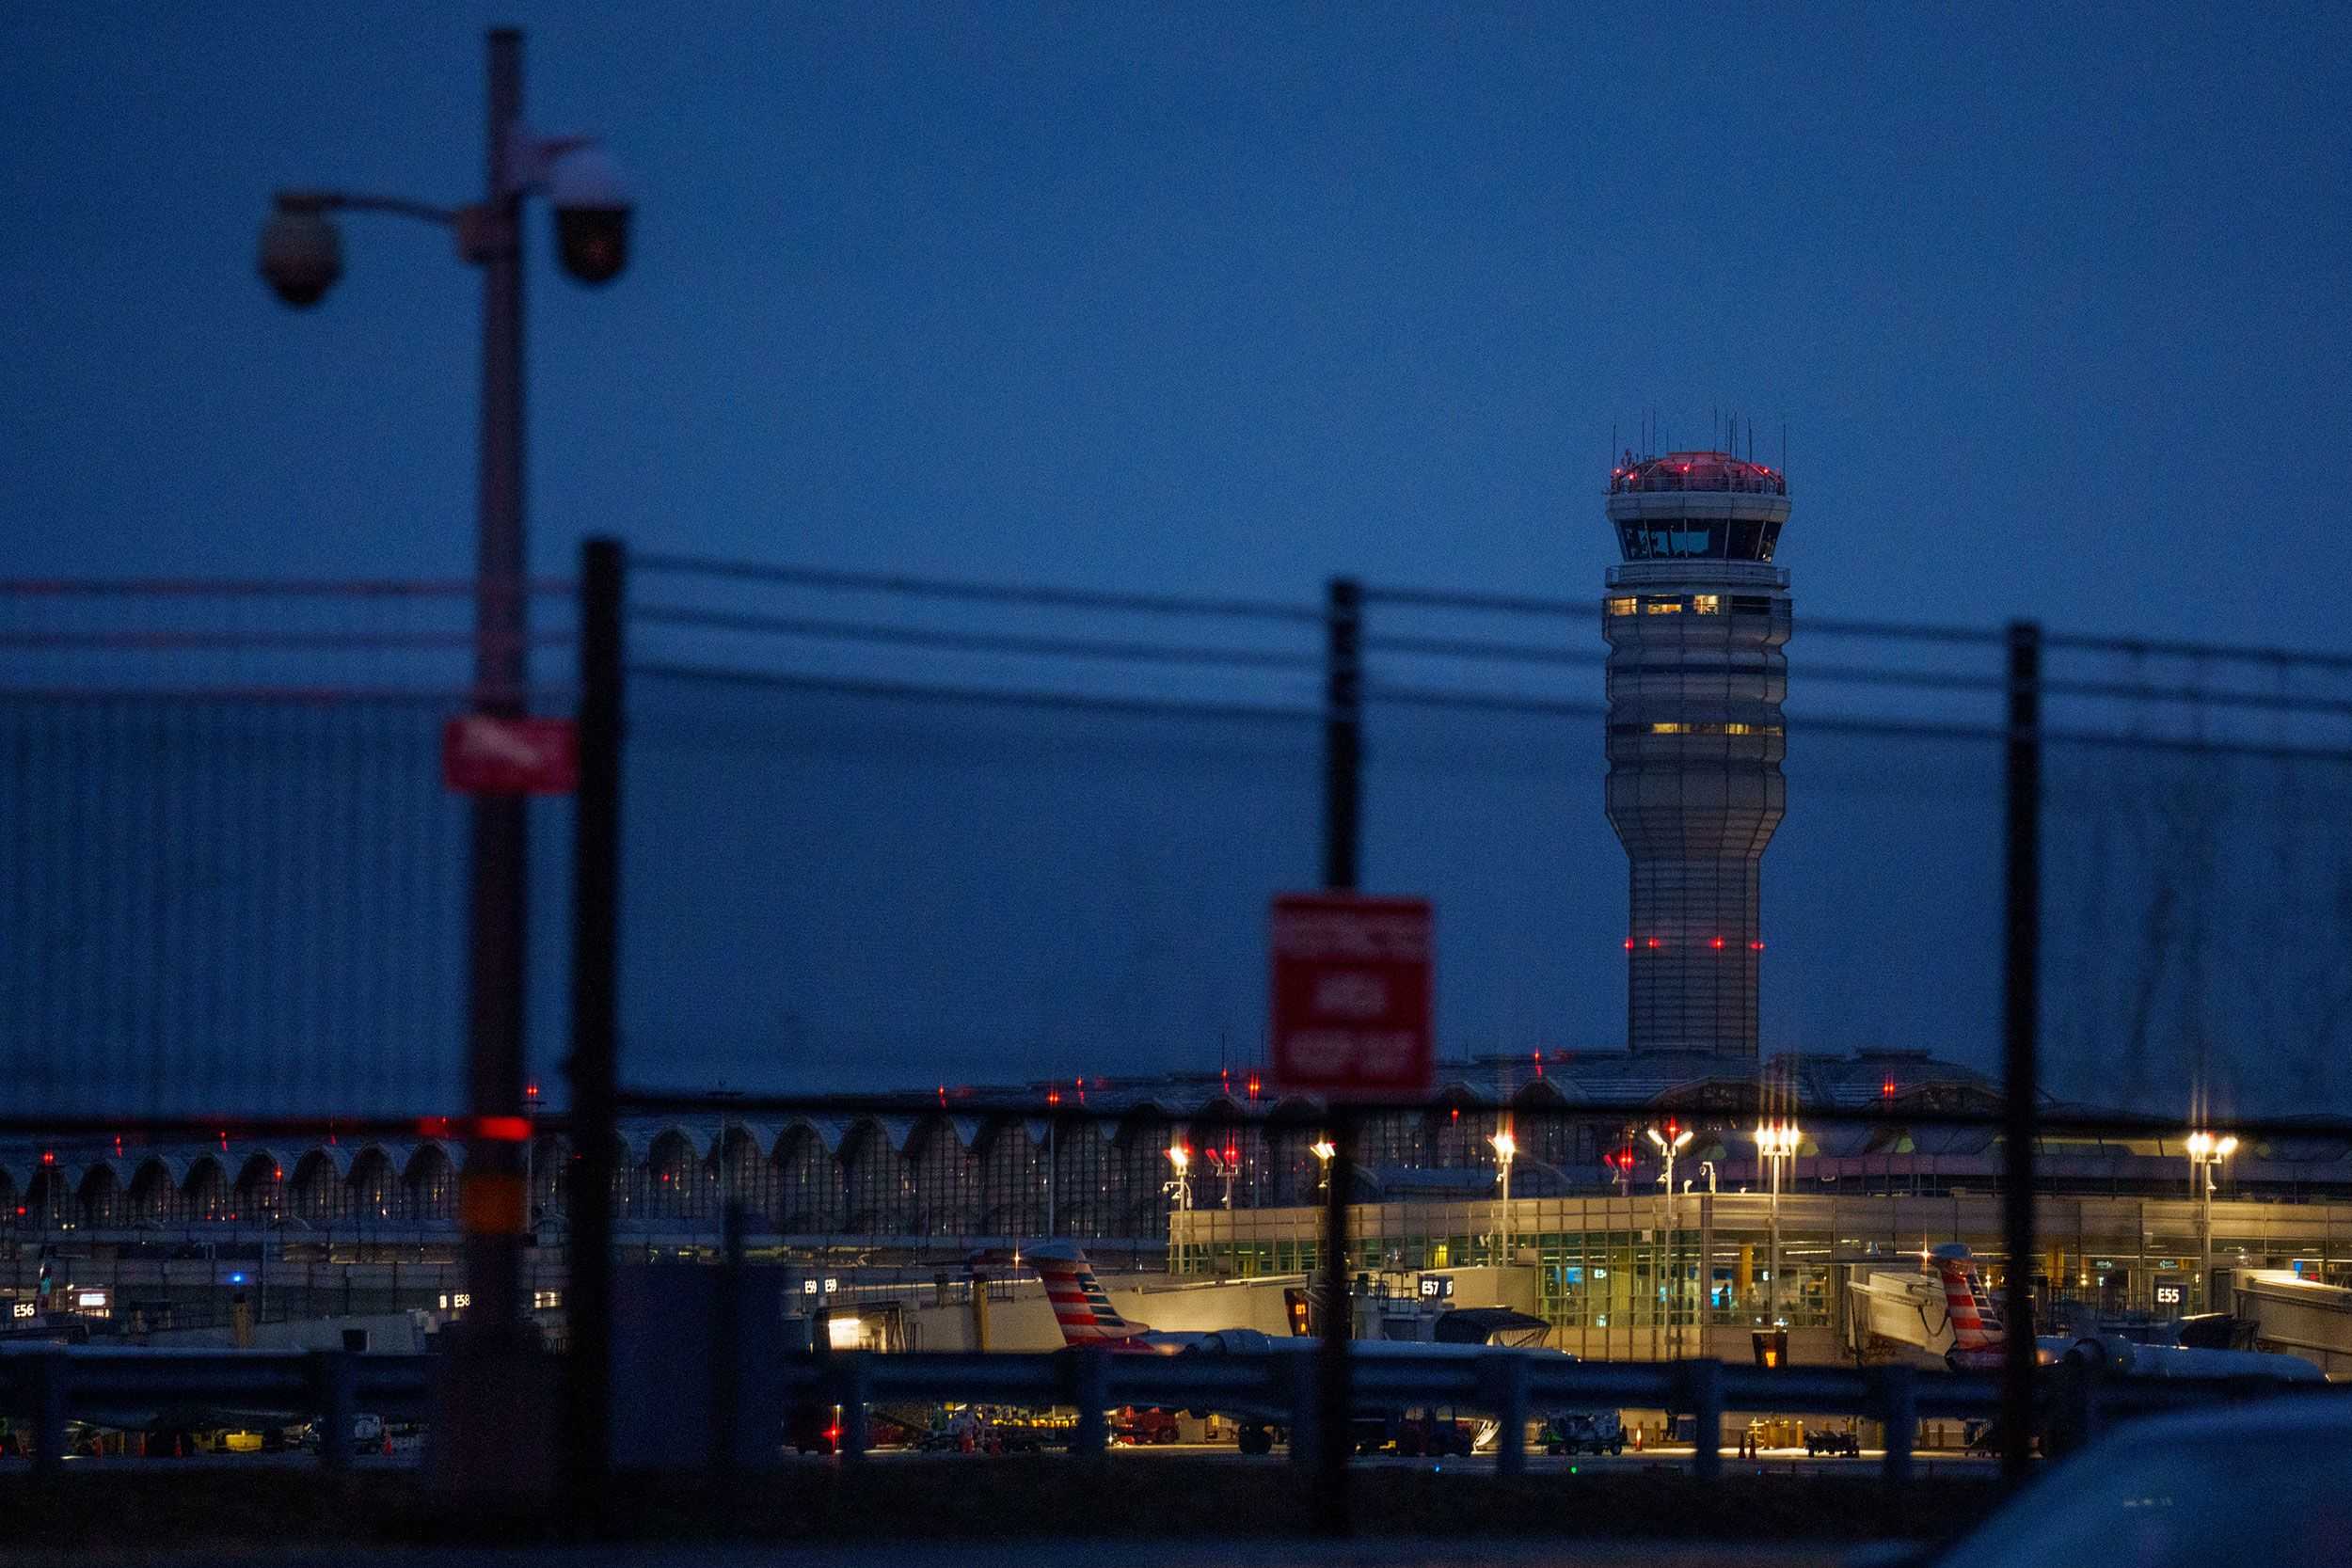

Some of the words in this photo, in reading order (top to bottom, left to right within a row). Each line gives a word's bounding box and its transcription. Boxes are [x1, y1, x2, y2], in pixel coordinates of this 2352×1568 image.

[1422, 1280, 1439, 1295] E57
[453, 1293, 470, 1308] E58
[2157, 1288, 2180, 1303] E55
[13, 1303, 35, 1318] E56
